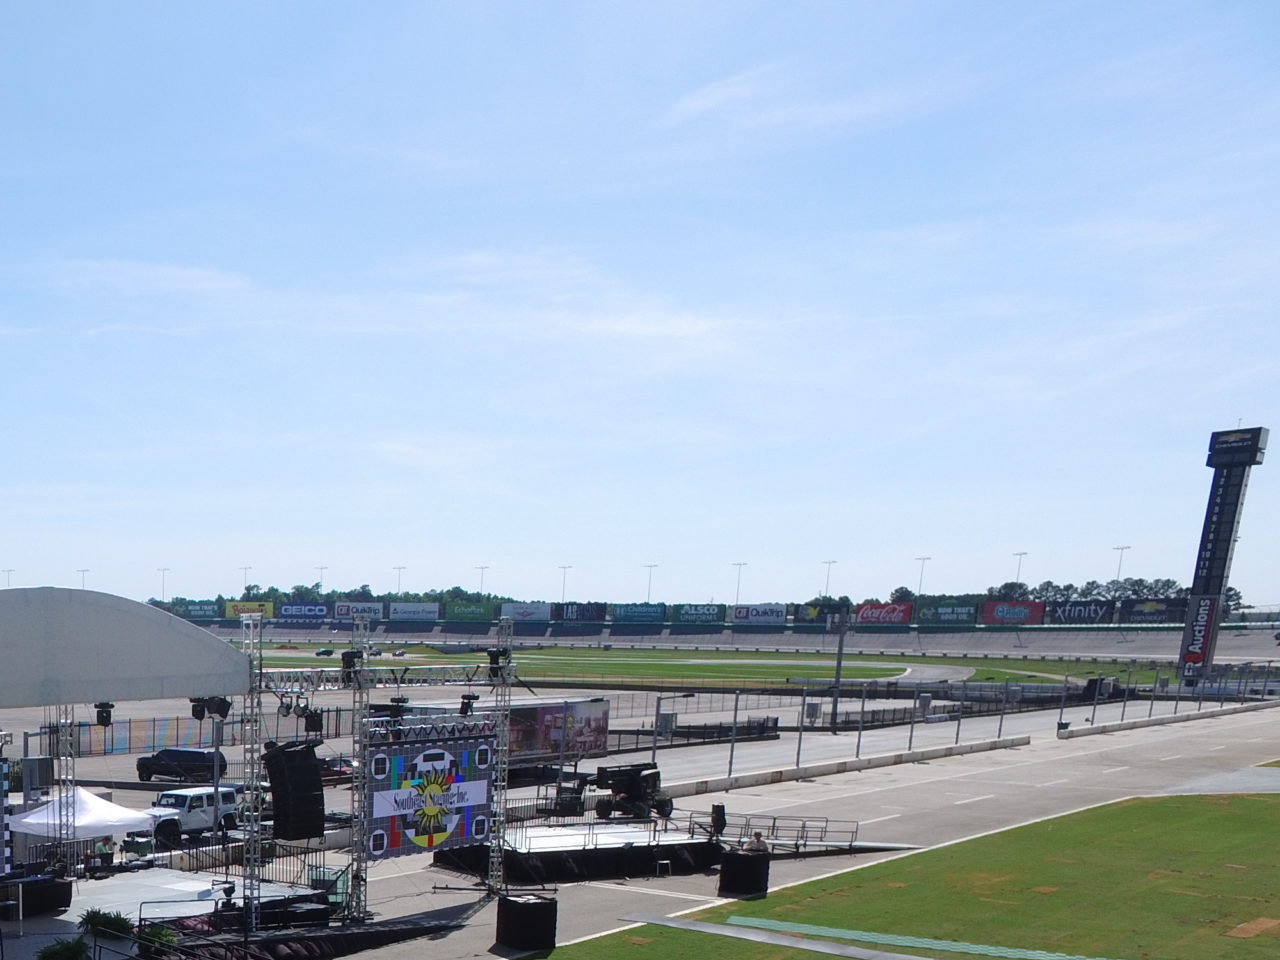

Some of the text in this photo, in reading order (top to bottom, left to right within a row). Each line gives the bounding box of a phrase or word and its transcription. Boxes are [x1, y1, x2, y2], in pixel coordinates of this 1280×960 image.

[281, 605, 327, 615] GEICO
[351, 606, 380, 615] QuikTrip
[681, 605, 718, 614] ALSCO
[751, 608, 784, 618] QuikTrip
[1055, 603, 1107, 622] xfinity
